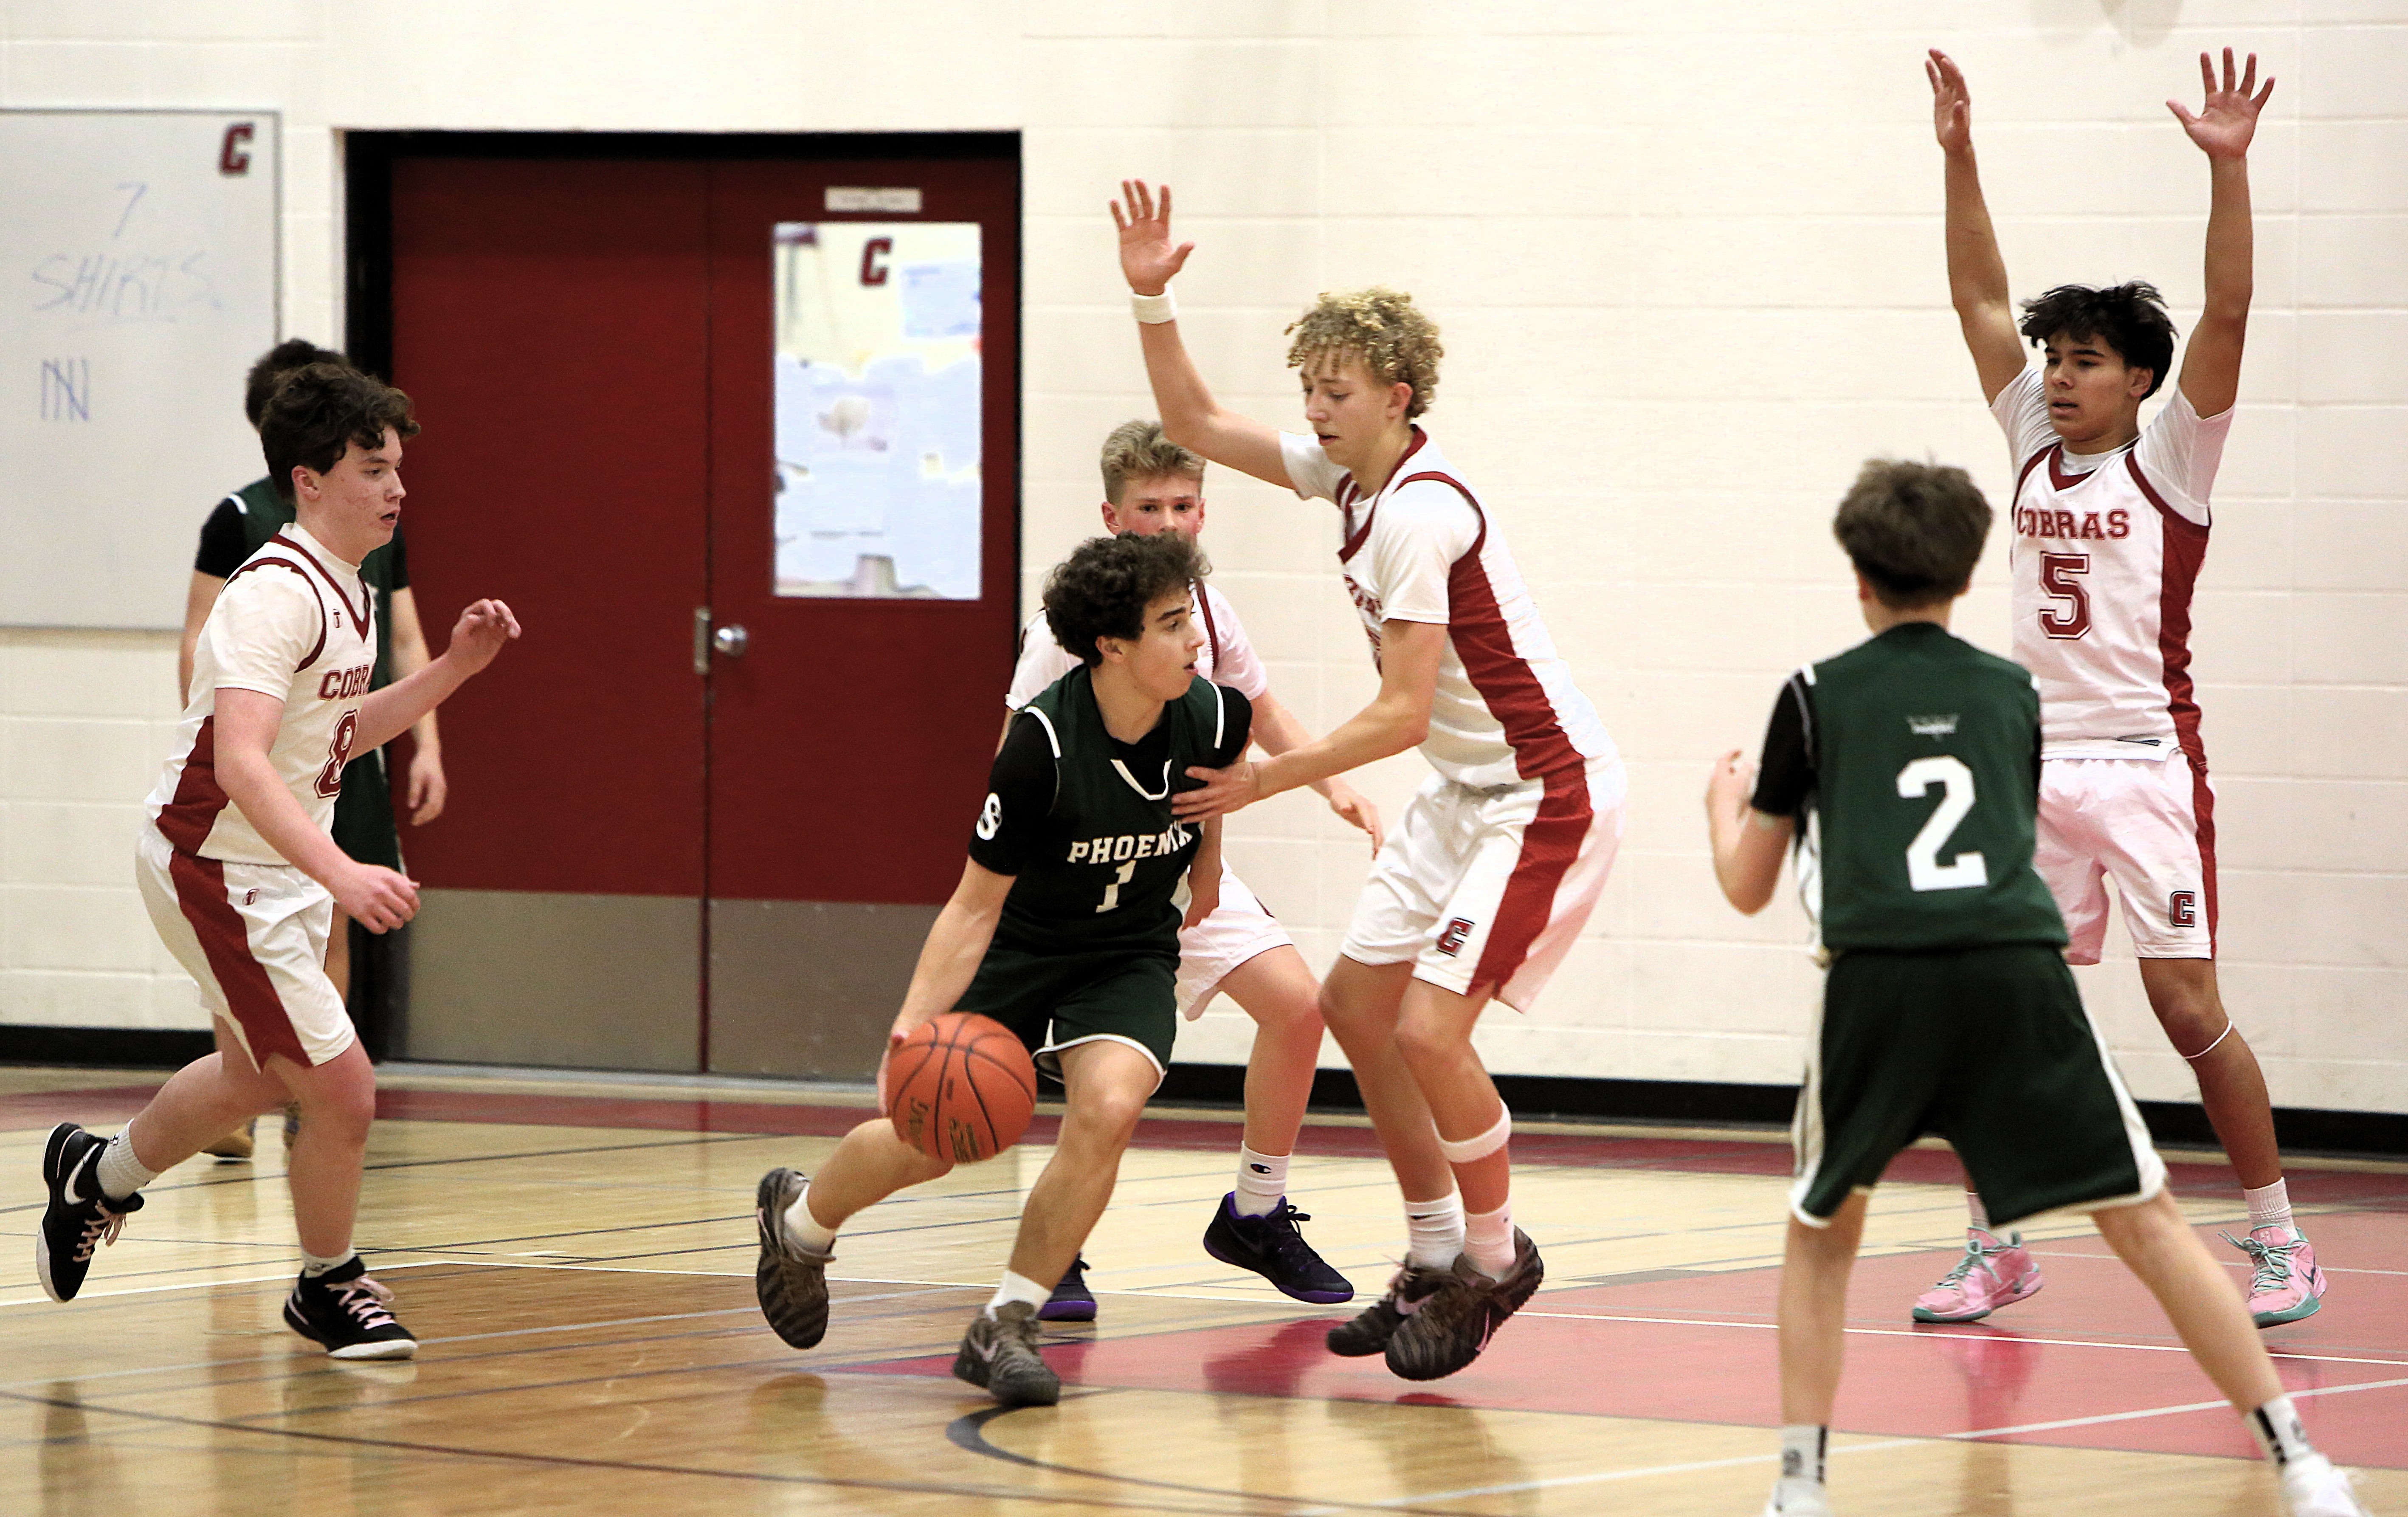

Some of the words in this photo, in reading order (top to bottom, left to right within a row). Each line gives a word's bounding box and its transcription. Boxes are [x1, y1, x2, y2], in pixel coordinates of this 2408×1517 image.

[218, 121, 256, 177] C
[2039, 550, 2092, 640] 5
[1895, 754, 1989, 892] 2
[1095, 860, 1137, 914] 1
[2169, 890, 2195, 928] C
